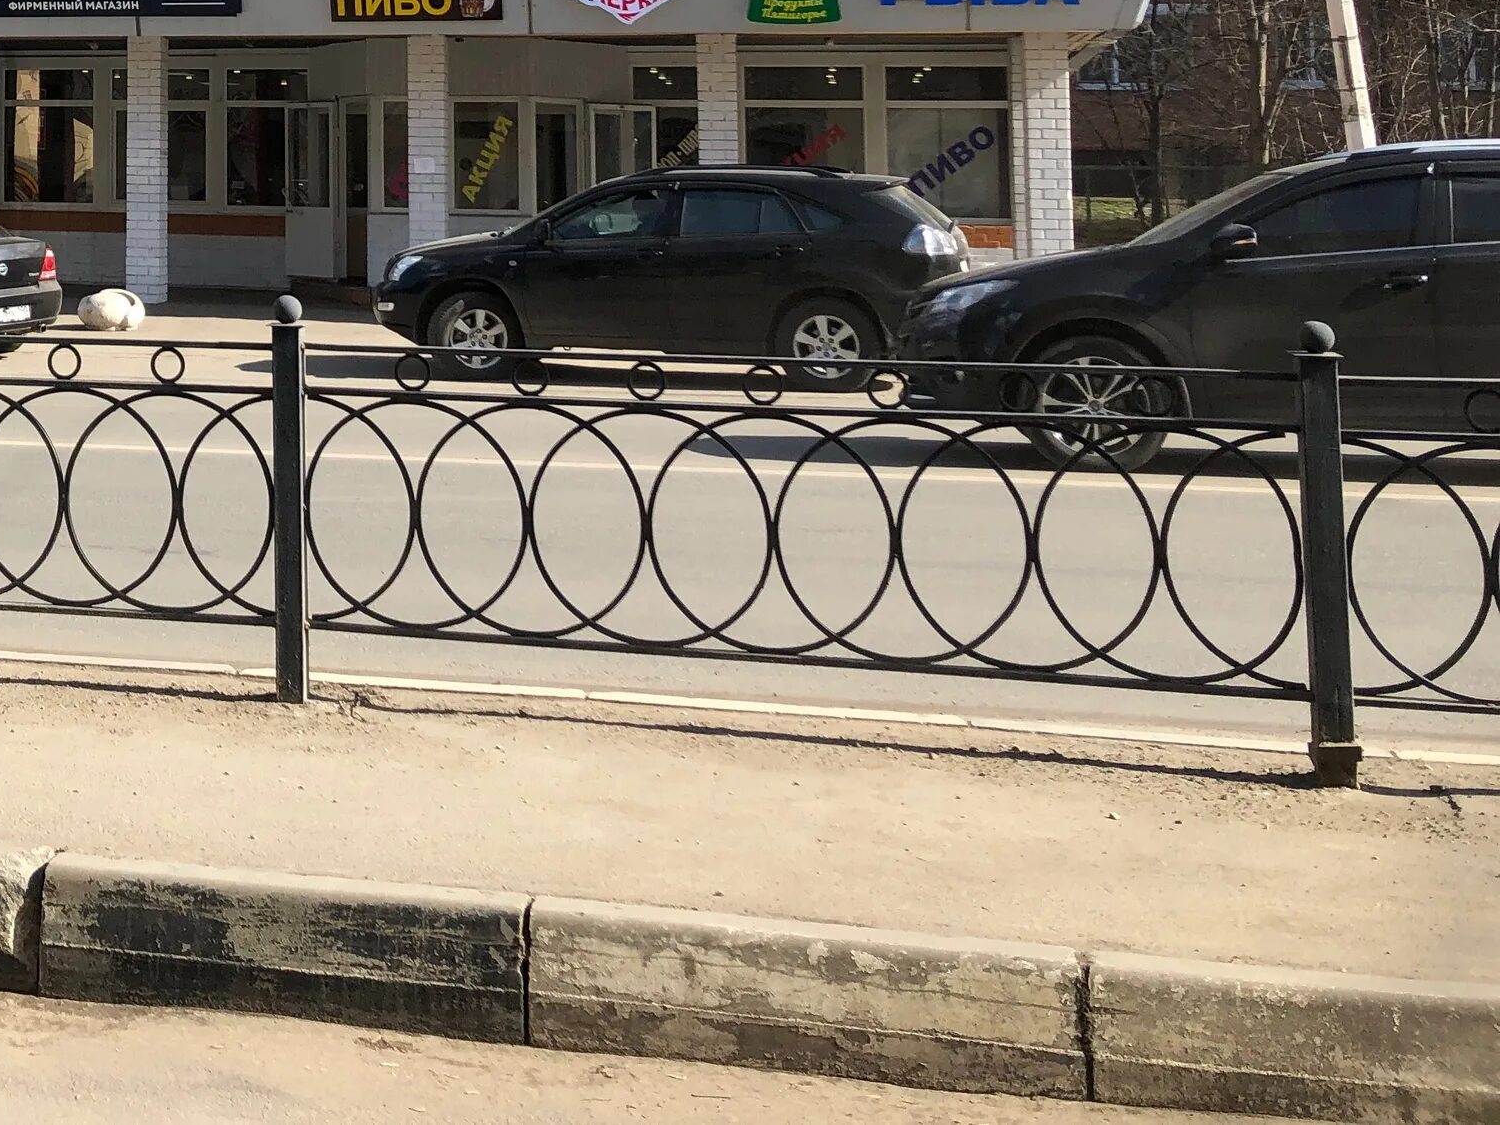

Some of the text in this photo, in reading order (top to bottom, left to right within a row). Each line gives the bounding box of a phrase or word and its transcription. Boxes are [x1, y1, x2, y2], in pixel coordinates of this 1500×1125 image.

[8, 0, 140, 11] ФИРМЕННЫЙ МАГАЗИН
[459, 111, 513, 205] АКЦИЯ
[907, 125, 995, 197] ПИВО
